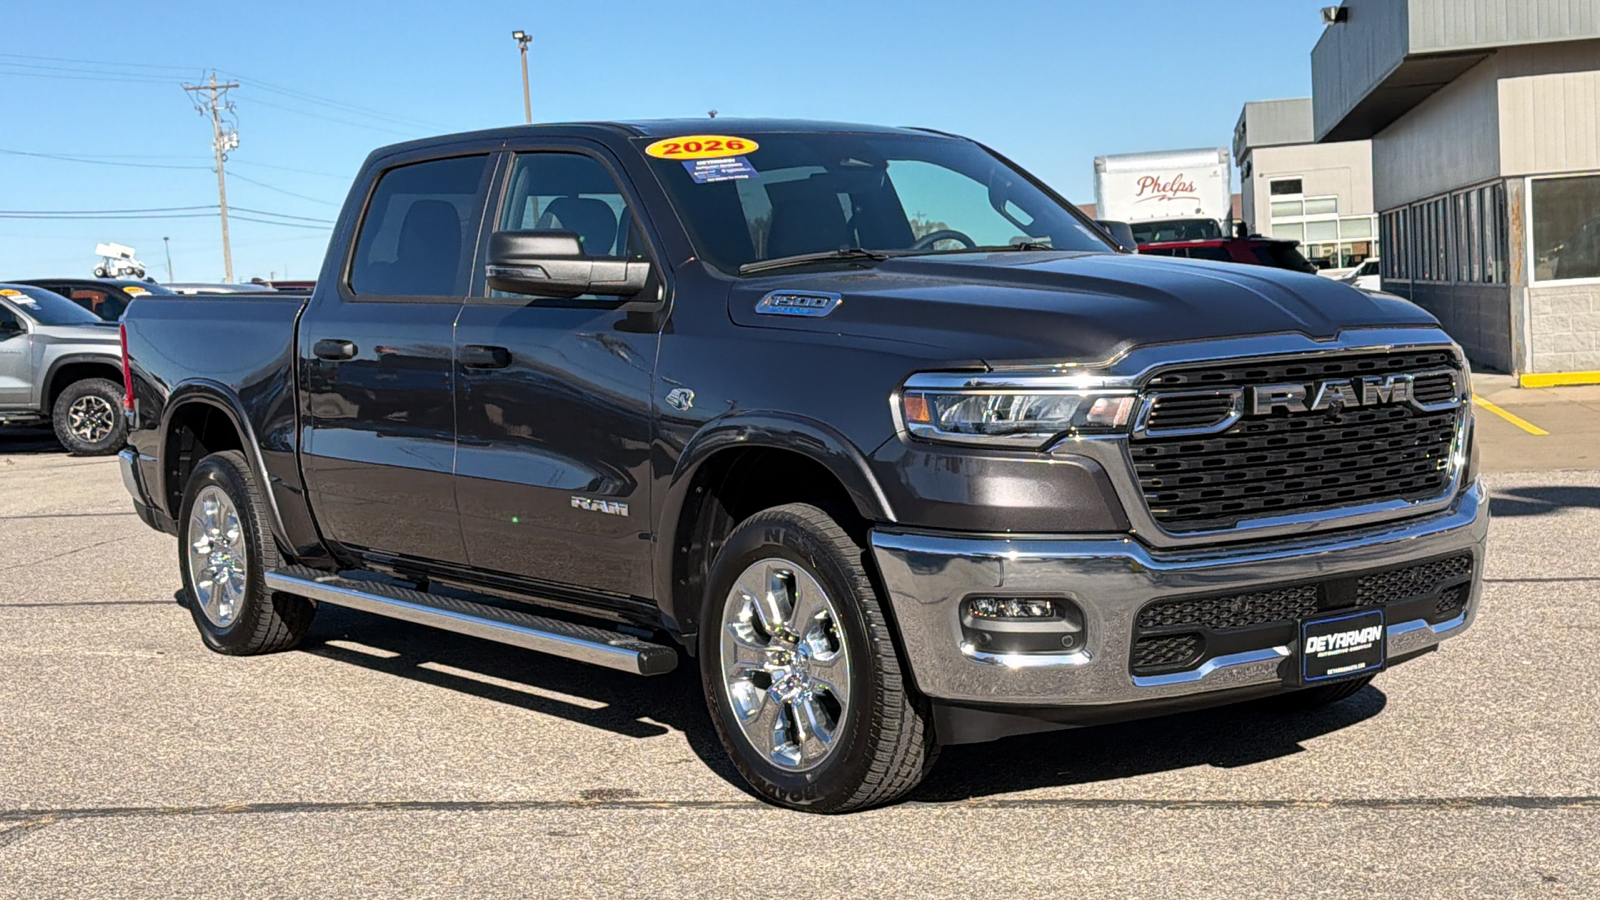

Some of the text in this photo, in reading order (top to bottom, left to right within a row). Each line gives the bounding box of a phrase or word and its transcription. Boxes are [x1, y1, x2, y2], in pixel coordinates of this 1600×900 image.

[662, 140, 746, 155] 2026
[1136, 173, 1197, 196] Phelps
[1253, 373, 1414, 415] RAM
[571, 496, 629, 517] RAM
[1305, 625, 1383, 654] DEYARMAN
